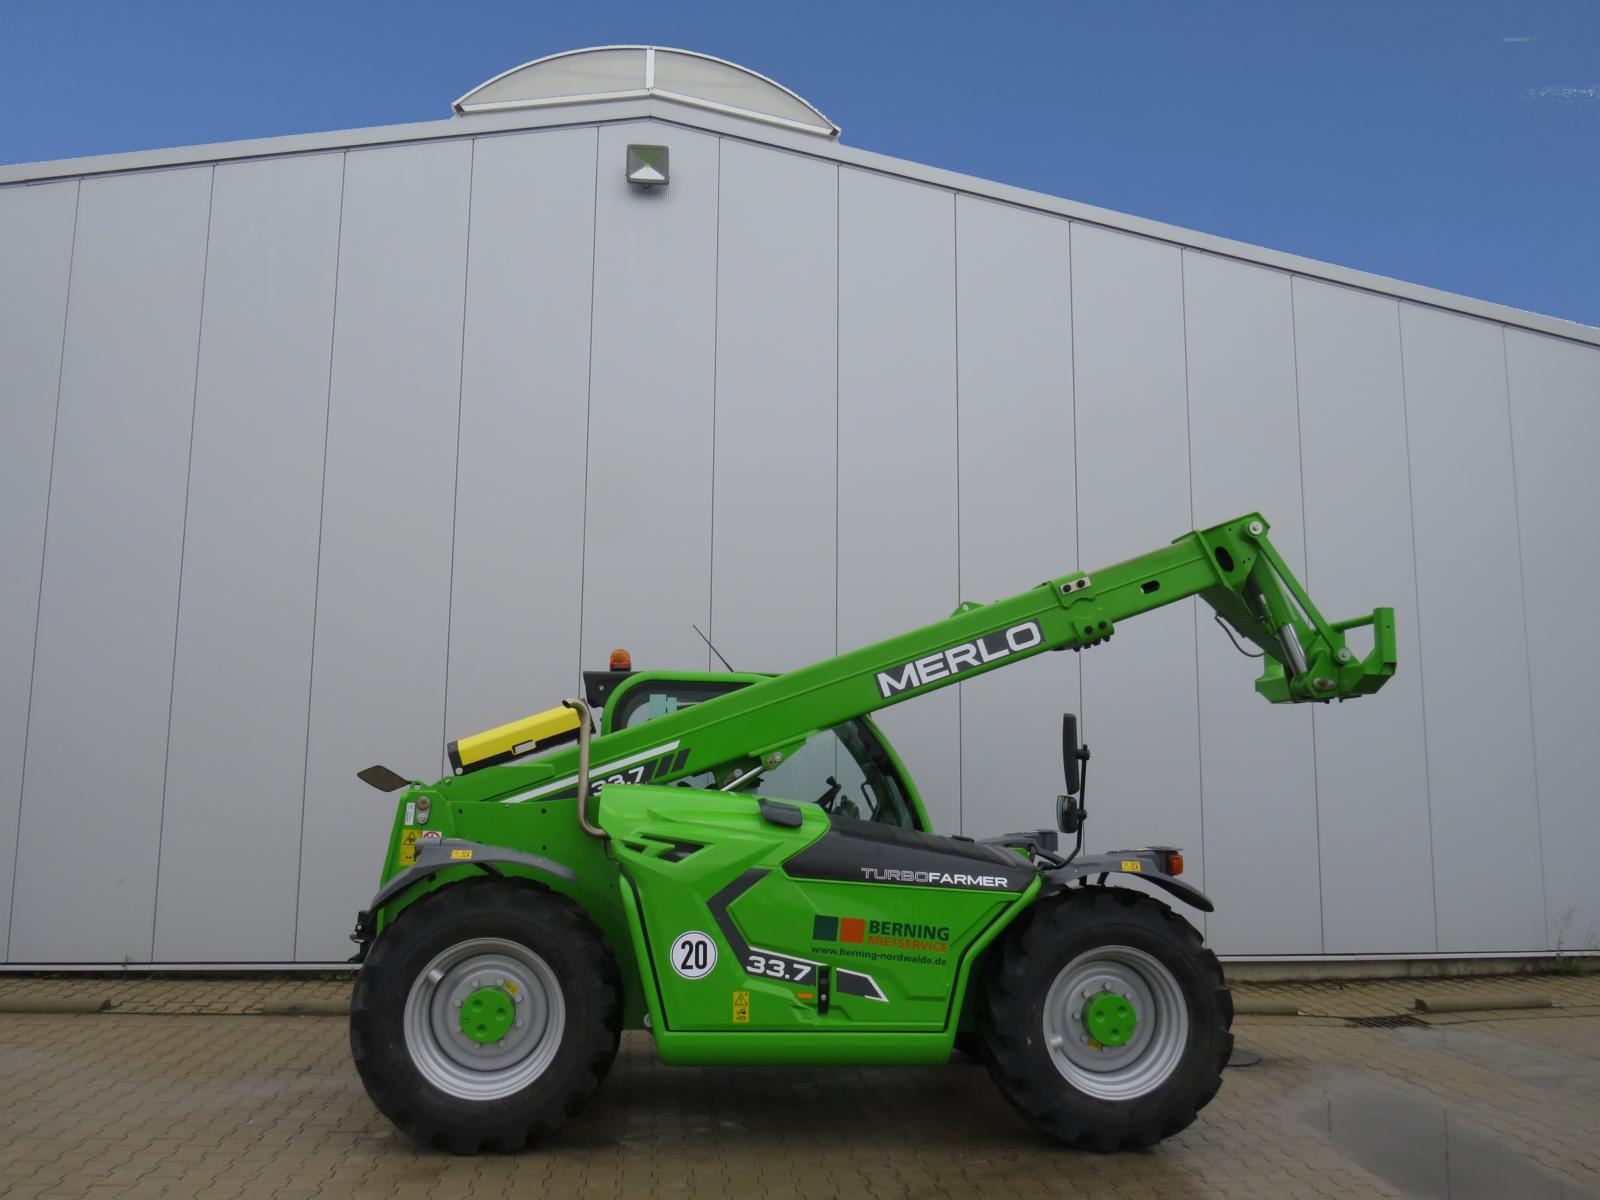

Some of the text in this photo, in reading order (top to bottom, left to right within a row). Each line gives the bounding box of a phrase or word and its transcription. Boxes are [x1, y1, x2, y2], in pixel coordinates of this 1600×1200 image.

[876, 621, 1041, 698] MERLO
[861, 867, 1008, 888] TURBOFARMER
[868, 920, 950, 941] BERNING
[868, 935, 948, 953] MIETSERVICE
[680, 940, 708, 970] 20
[811, 946, 948, 966] www.berning-nordwalde.de
[746, 955, 812, 981] 33.7
